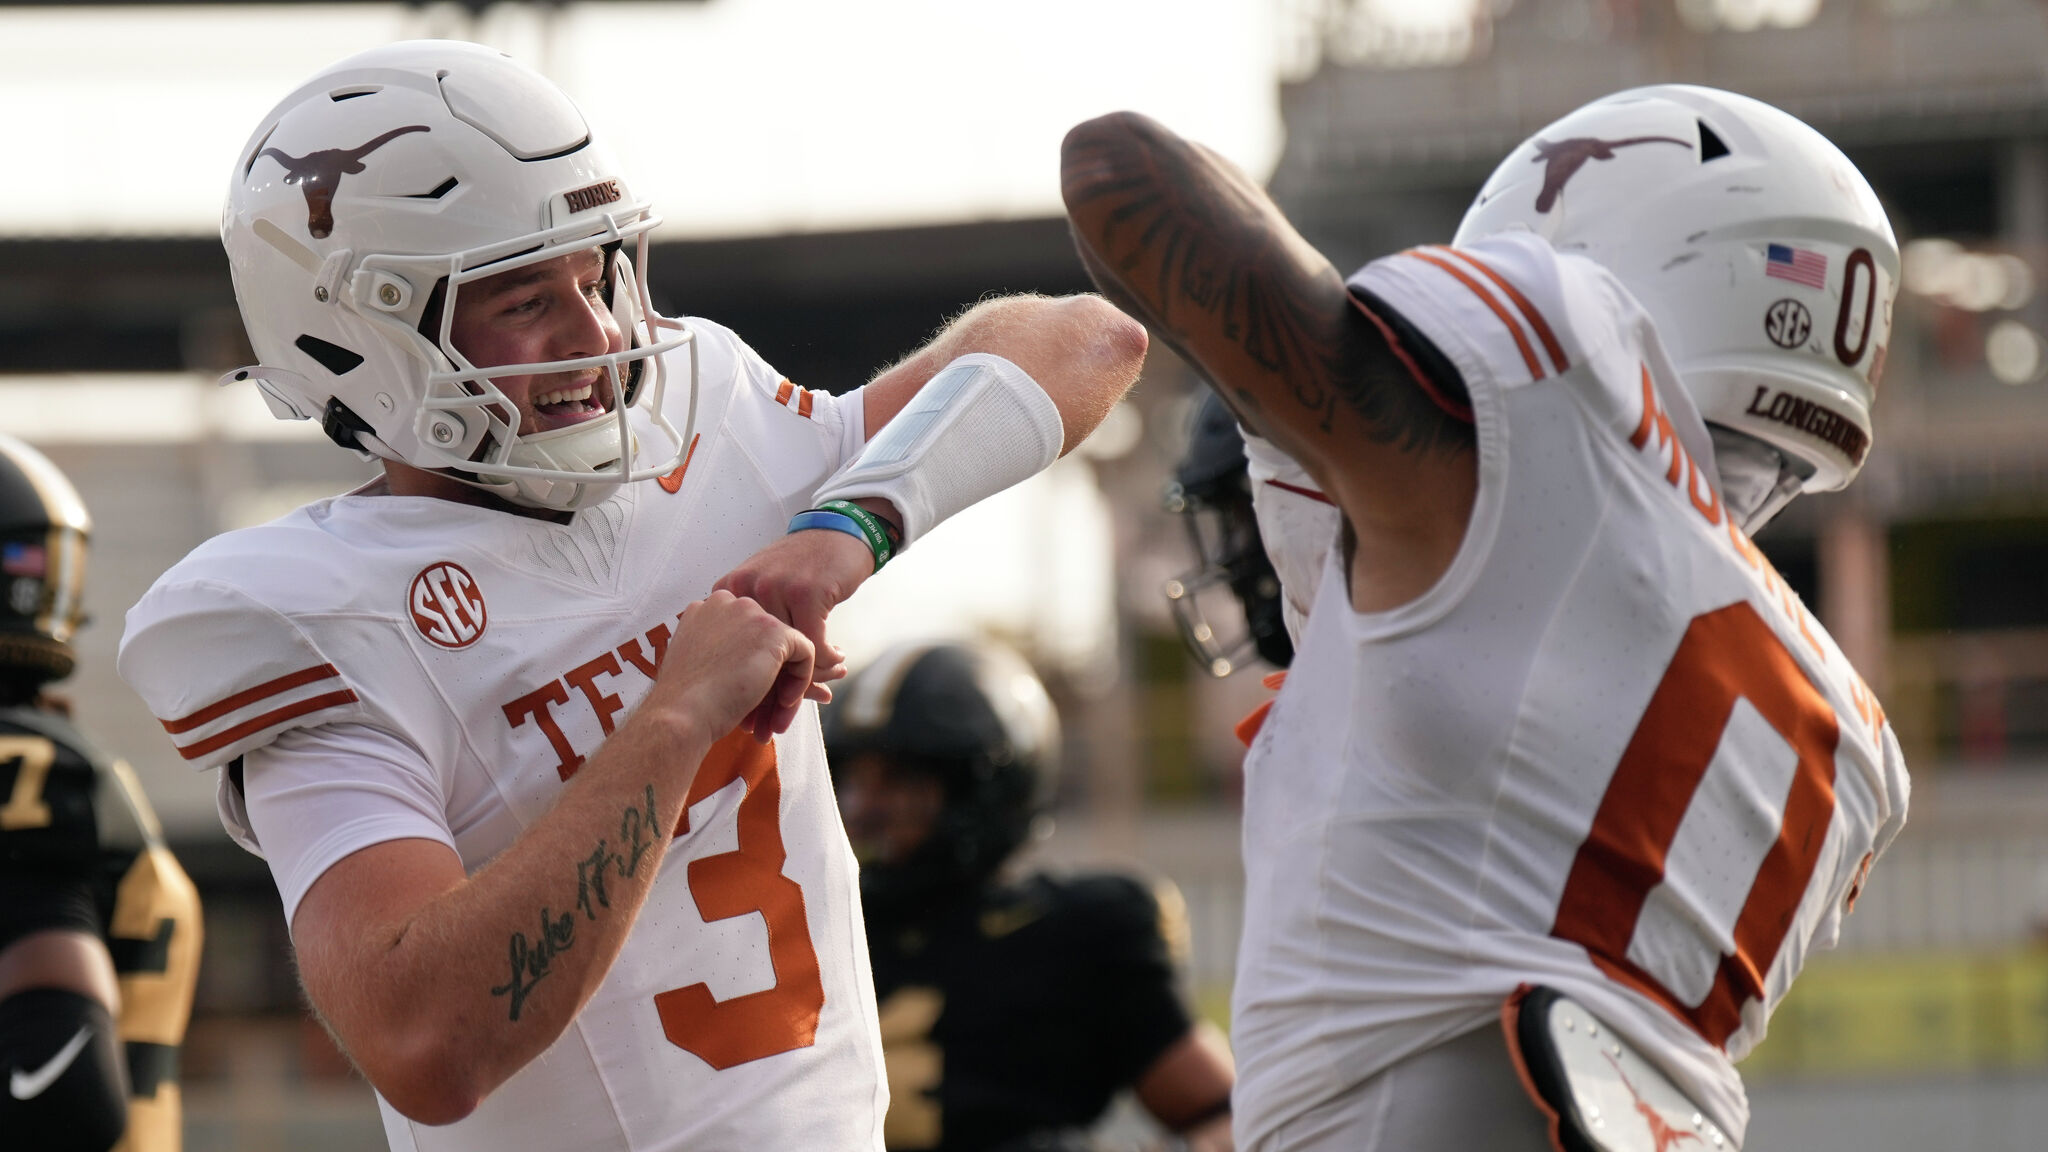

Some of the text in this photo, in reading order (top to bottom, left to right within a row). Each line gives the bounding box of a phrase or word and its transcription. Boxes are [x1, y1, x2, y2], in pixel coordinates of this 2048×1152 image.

[563, 179, 621, 214] HORNS
[1765, 298, 1812, 349] SEC
[1834, 247, 1877, 367] 0
[1746, 384, 1869, 466] LONGHOR
[863, 517, 878, 533] MEAN
[409, 562, 487, 648] SEC
[1552, 600, 1840, 1052] 0
[654, 727, 826, 1071] 3
[491, 906, 575, 1021] Luke
